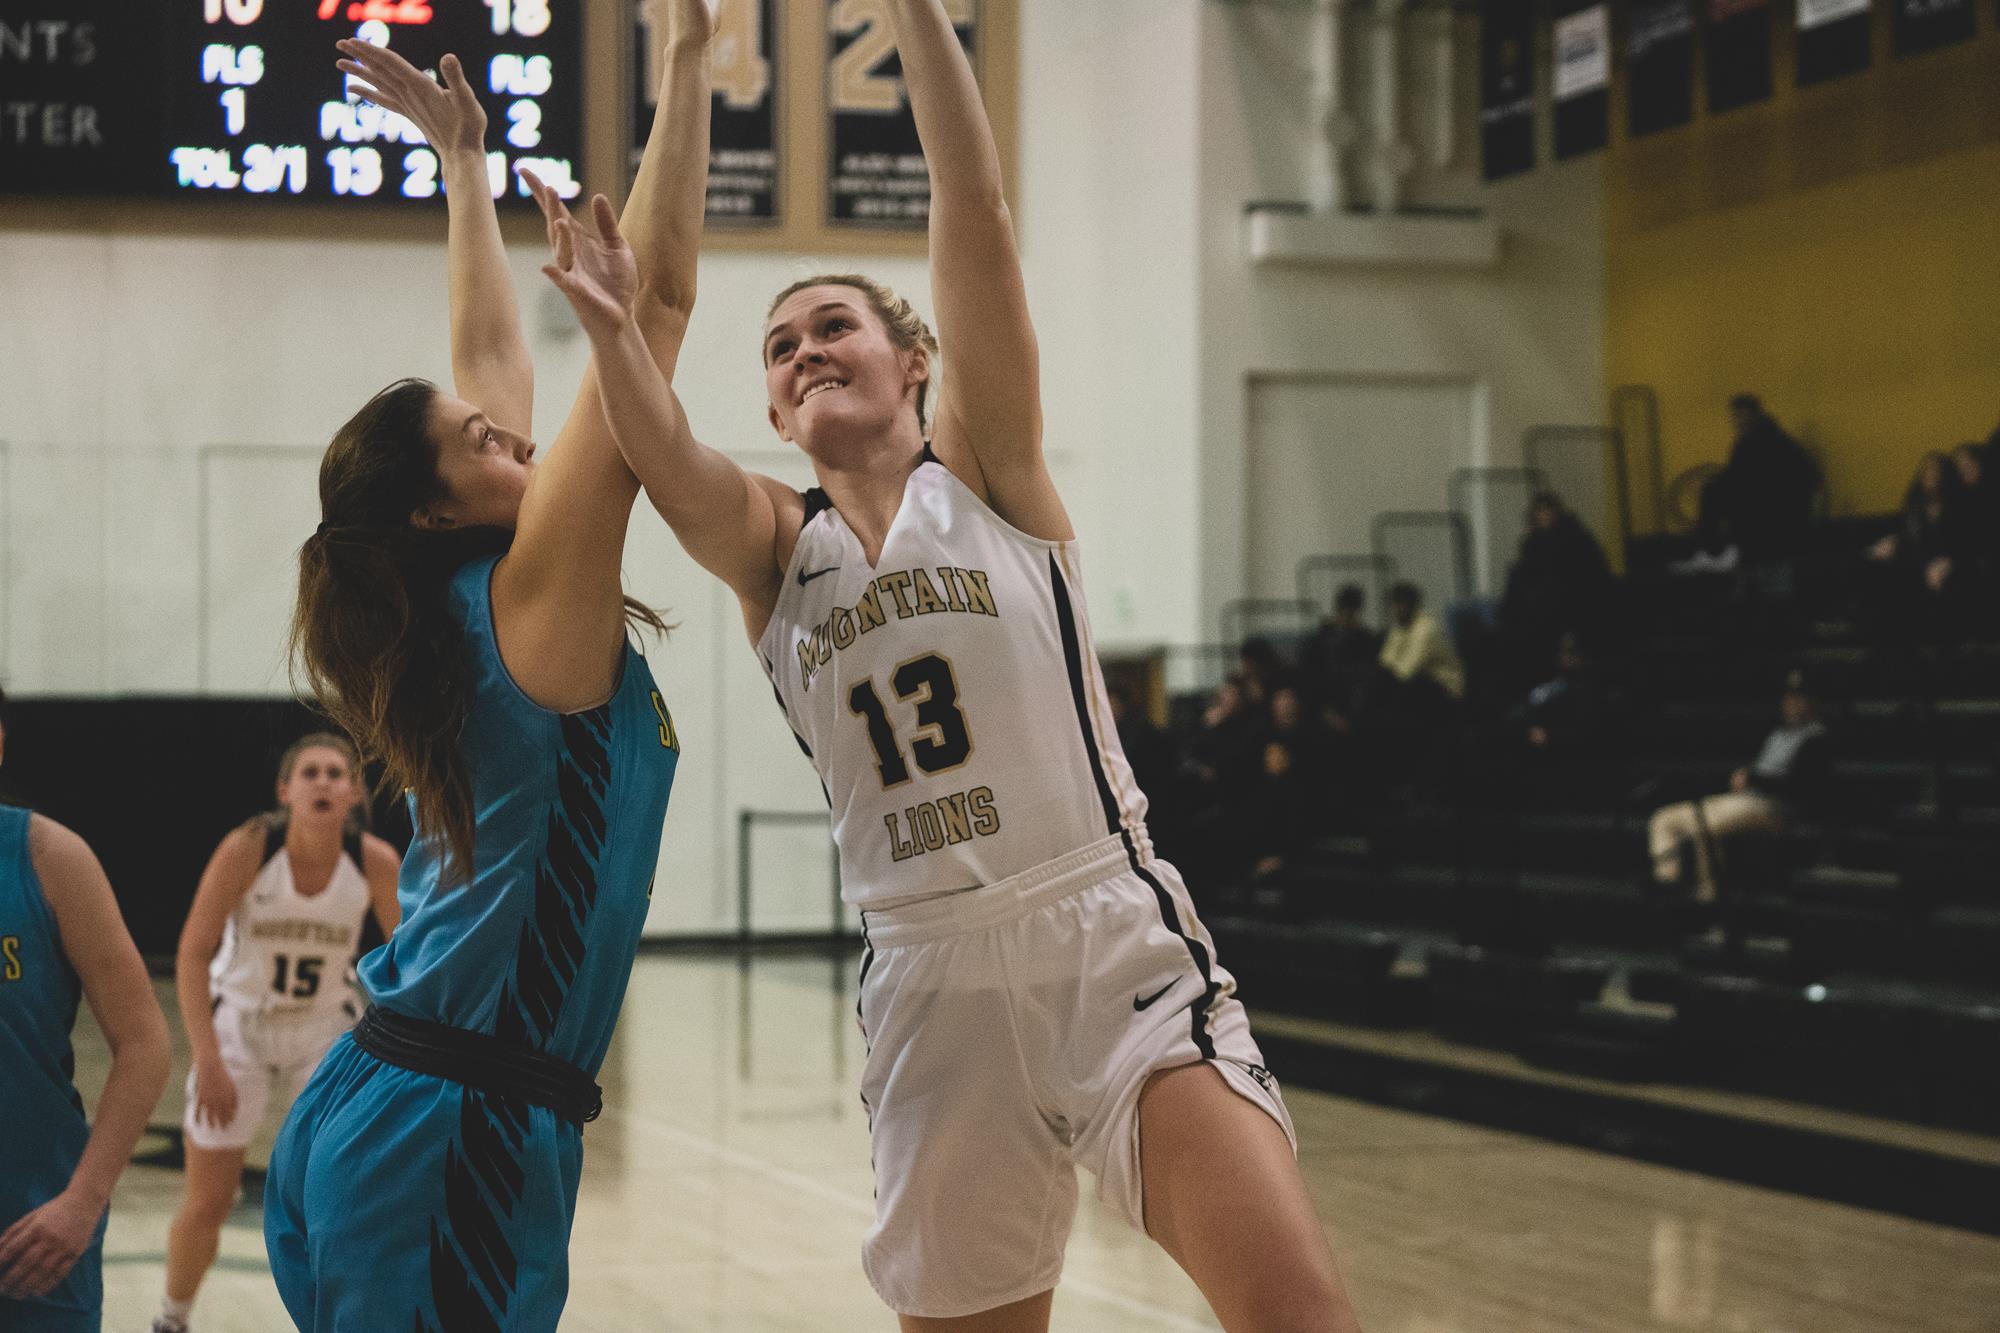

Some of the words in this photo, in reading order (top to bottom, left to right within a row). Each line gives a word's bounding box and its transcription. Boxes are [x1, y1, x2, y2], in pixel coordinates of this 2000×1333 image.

[201, 43, 265, 85] FLS
[488, 54, 552, 96] FLS
[6, 102, 103, 146] TER
[219, 87, 245, 136] 1
[506, 98, 542, 149] 2
[169, 146, 241, 189] TOL
[325, 146, 383, 196] 13
[402, 148, 438, 198] 2
[797, 566, 999, 692] MOUNTAIN
[846, 650, 976, 791] 13
[884, 786, 1001, 862] LIONS
[272, 952, 325, 998] 15
